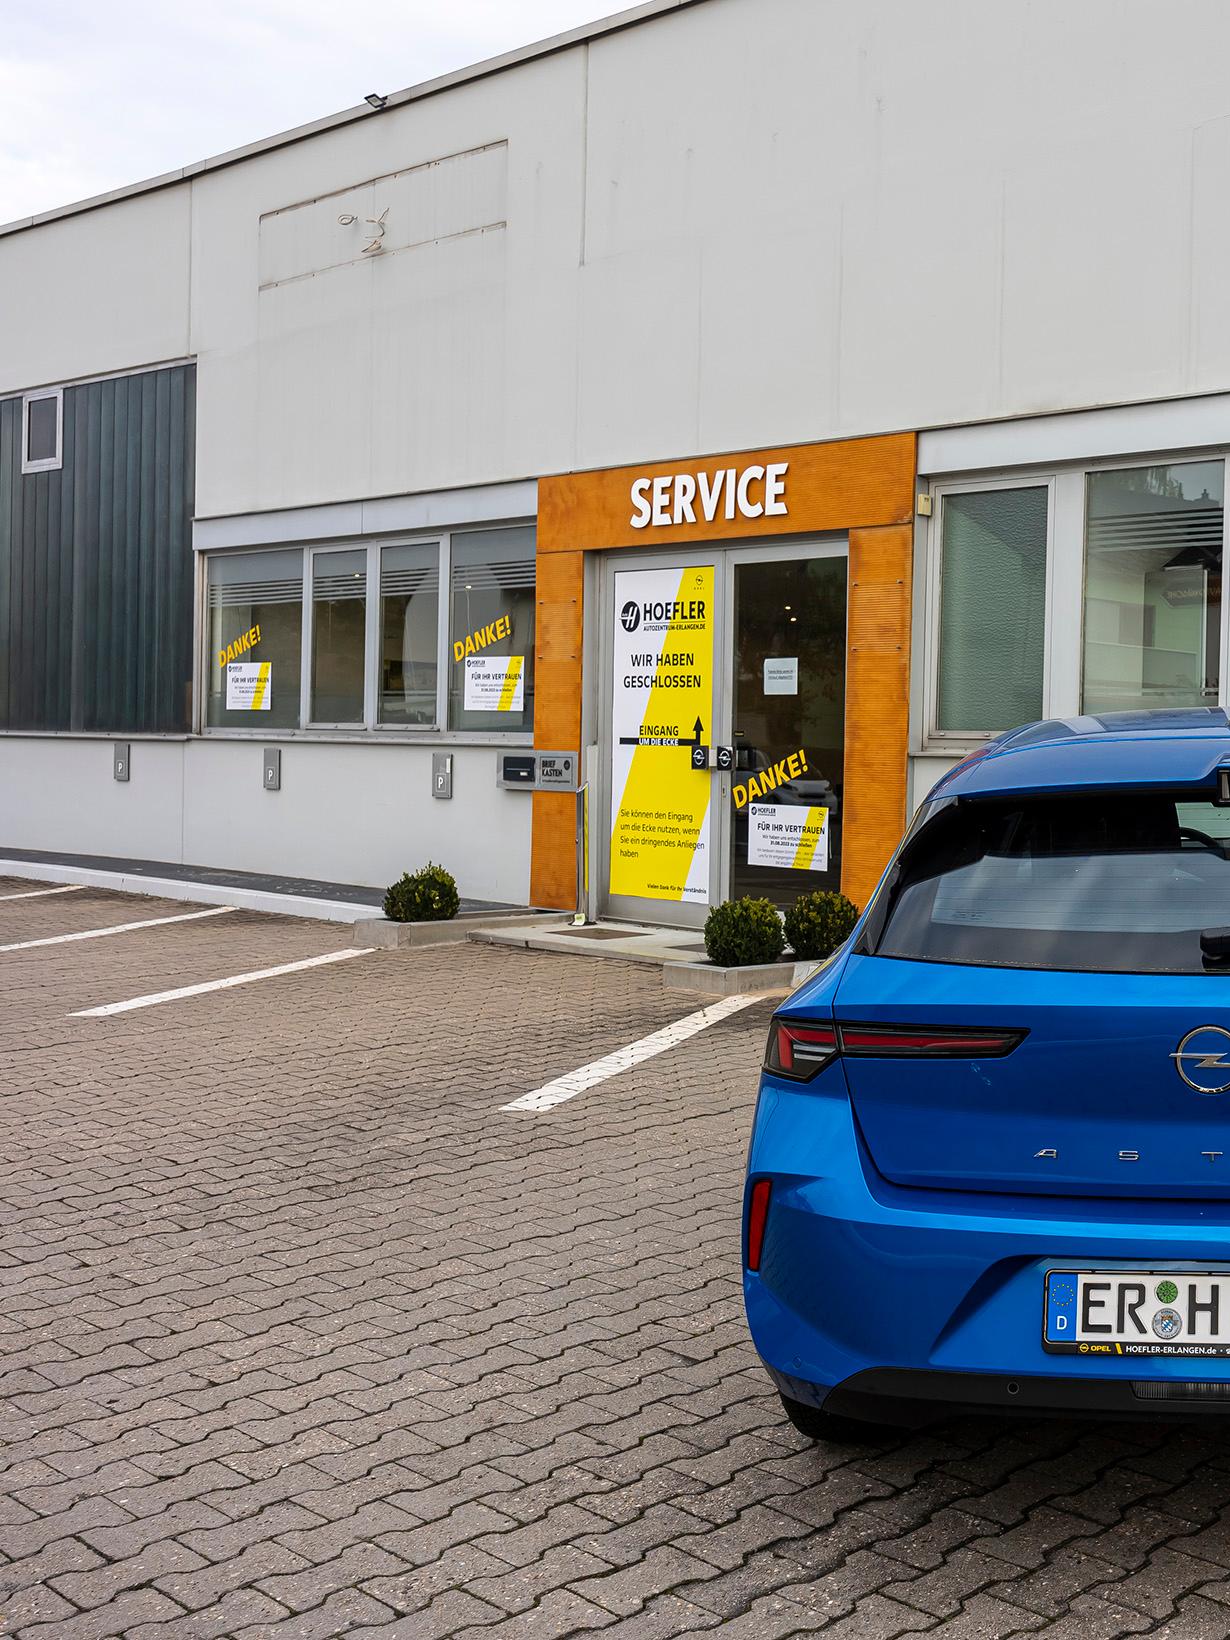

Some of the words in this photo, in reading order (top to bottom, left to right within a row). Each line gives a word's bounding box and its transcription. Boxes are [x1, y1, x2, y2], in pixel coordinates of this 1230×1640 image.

[630, 462, 789, 529] SERVICE
[643, 601, 706, 621] HOEFLER
[643, 624, 706, 632] AUTOZENTRUM-ERLANGEN.DE
[453, 615, 511, 662] DANKE!
[218, 624, 260, 668] DANKE!
[631, 654, 653, 666] WIR
[656, 653, 694, 666] HABEN
[472, 672, 481, 680] FÜR
[624, 675, 701, 688] GESCHLOSSEN
[640, 725, 679, 736] EINGANG
[268, 770, 273, 780] P
[542, 769, 563, 777] KASTEN
[732, 749, 808, 809] DANKE!
[438, 777, 444, 789] P
[620, 809, 630, 818] Sie
[631, 810, 653, 819] können
[668, 812, 693, 823] Eingang
[631, 823, 640, 831] die
[642, 824, 656, 832] Ecke
[657, 826, 680, 835] nutzen,
[757, 821, 770, 831] FÜR
[785, 825, 825, 834] VERTRAUEN
[620, 836, 630, 844] Sie
[641, 837, 676, 848] dringendes
[677, 840, 704, 851] Anliegen
[620, 849, 639, 858] haben
[1056, 1316, 1067, 1330] D
[1082, 1282, 1148, 1334] ER
[1188, 1284, 1219, 1335] H
[1126, 1346, 1217, 1355] HOEFLER-ERLANGEN.de
